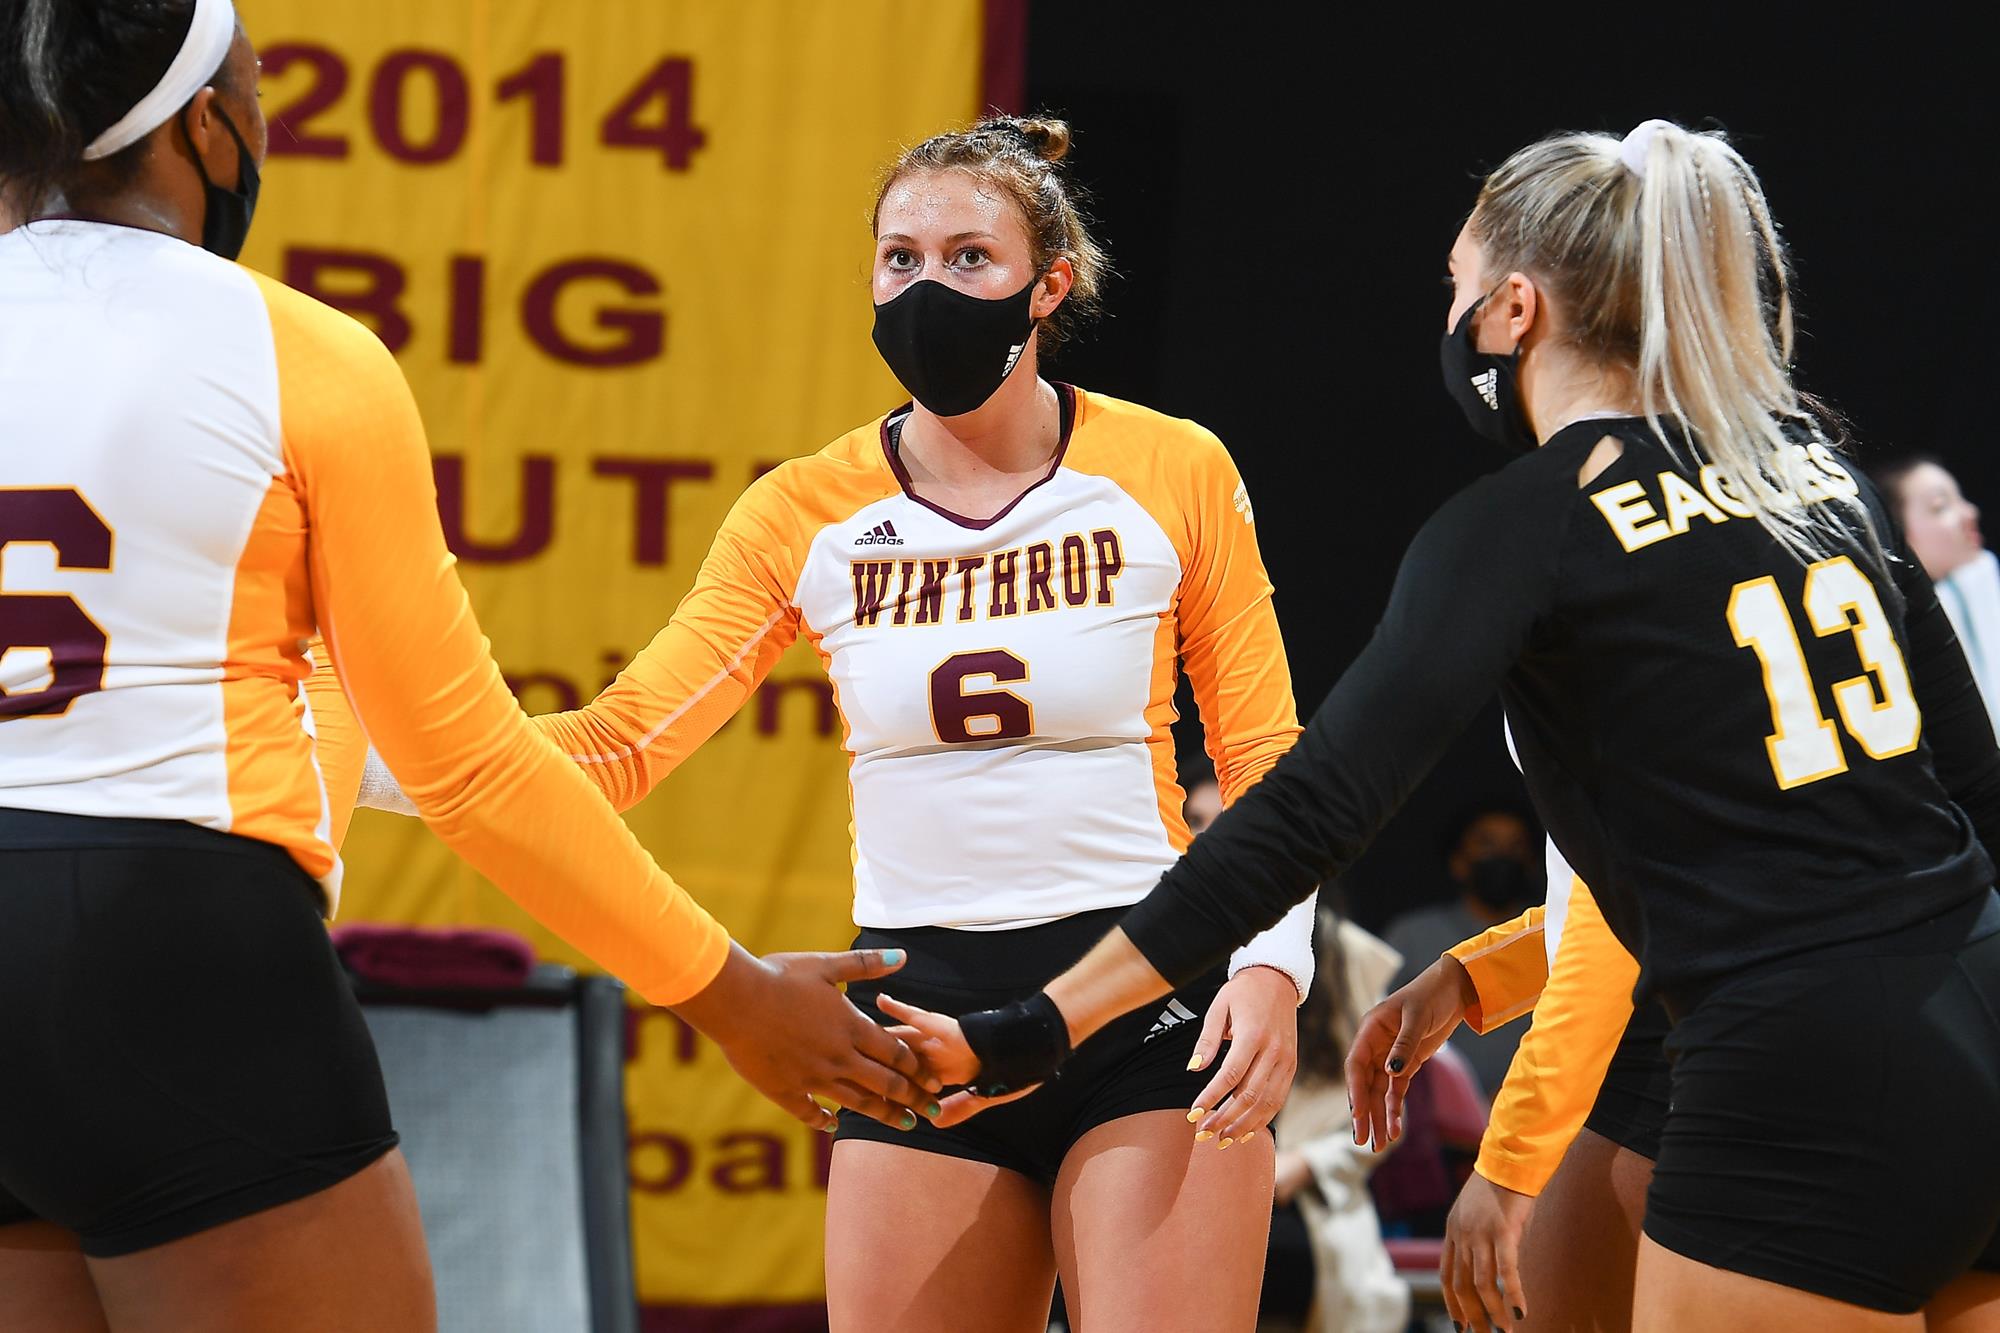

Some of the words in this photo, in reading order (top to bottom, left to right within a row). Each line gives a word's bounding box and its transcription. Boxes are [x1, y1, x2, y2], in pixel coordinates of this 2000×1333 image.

[258, 41, 709, 174] 2014
[283, 244, 667, 370] BIG
[433, 452, 788, 570] UT
[854, 534, 905, 546] adidas
[850, 527, 1125, 628] WINTHROP
[927, 647, 1036, 744] 6
[1726, 555, 1922, 790] 13
